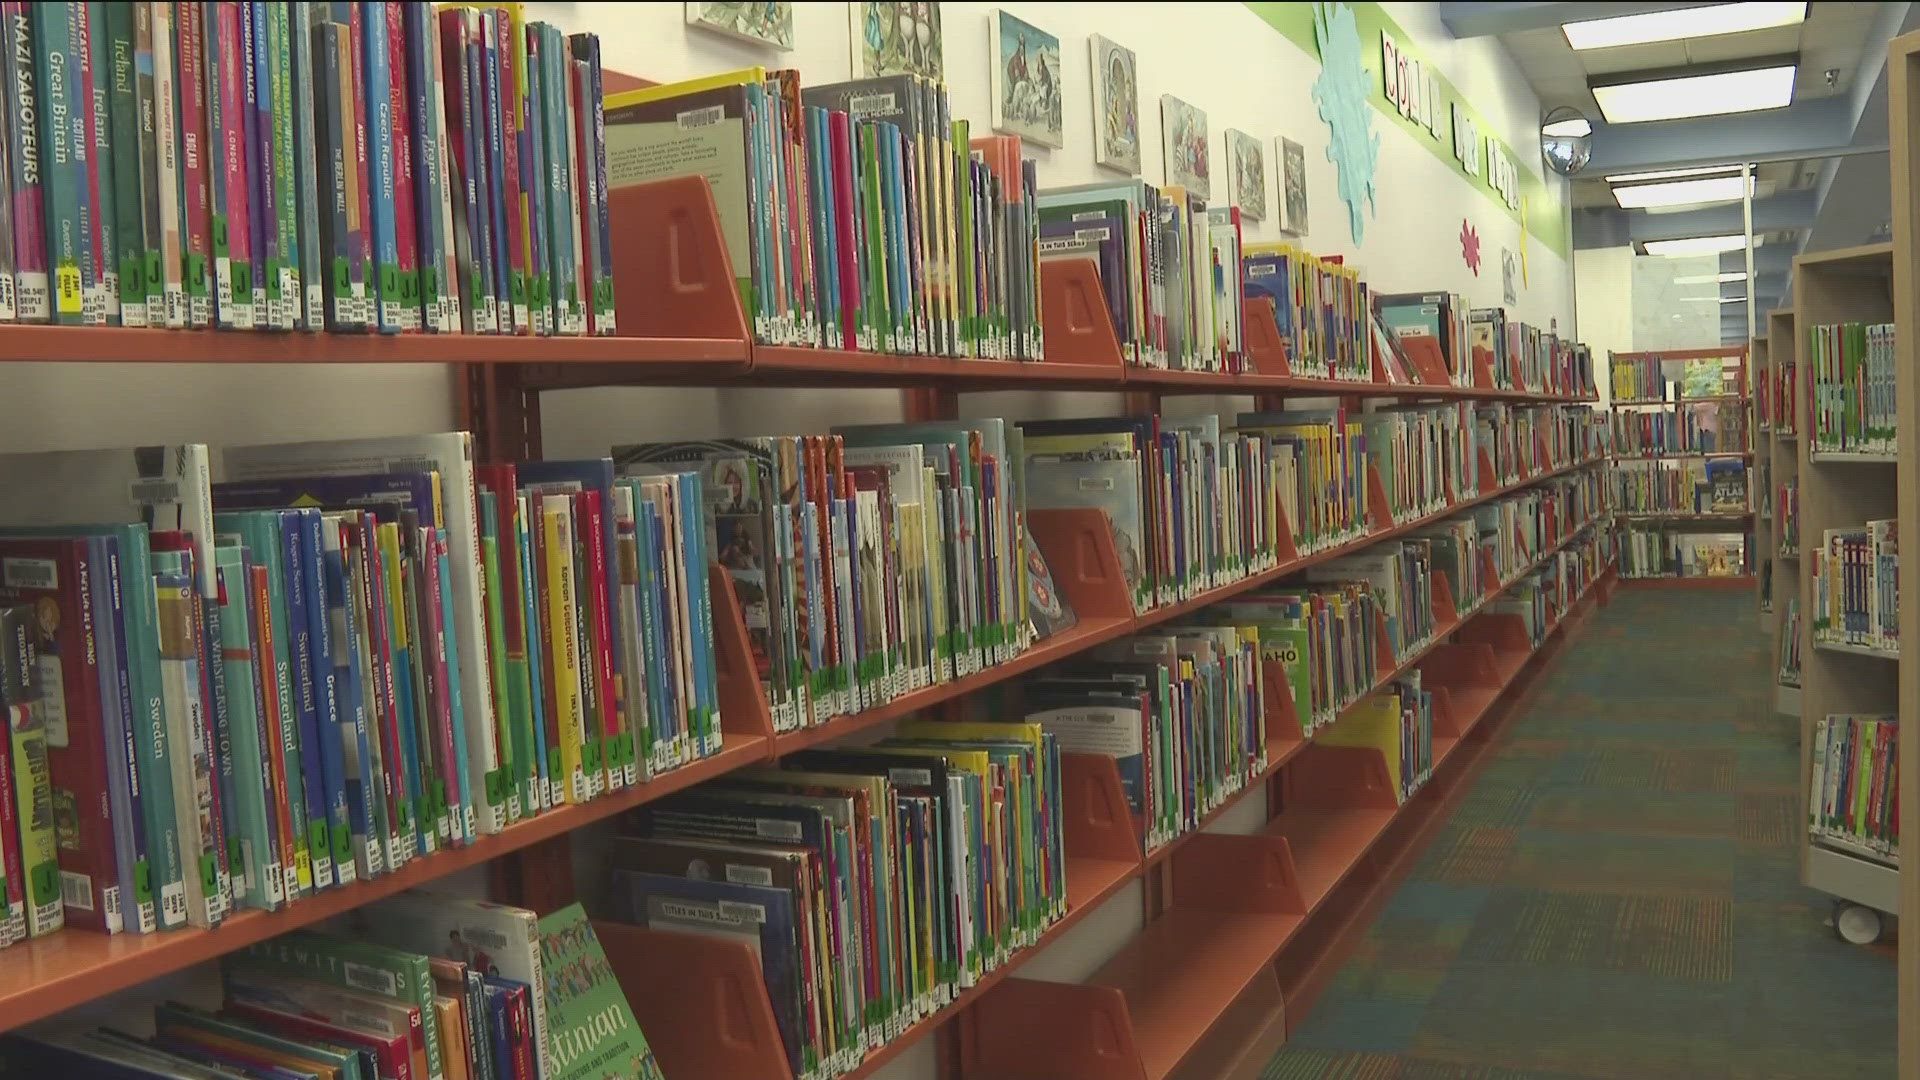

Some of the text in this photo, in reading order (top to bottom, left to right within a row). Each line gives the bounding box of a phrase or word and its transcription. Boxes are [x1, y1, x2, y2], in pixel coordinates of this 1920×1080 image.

[79, 30, 88, 72] CASTLE
[115, 39, 131, 92] Ireland
[14, 15, 38, 184] NAZI SABOTEURS
[246, 65, 255, 103] PALACE
[490, 90, 496, 102] OF
[50, 52, 70, 163] Great Britain
[93, 88, 108, 147] Ireland
[143, 99, 152, 132] Ireland
[390, 87, 402, 131] Poland
[491, 103, 499, 152] VERSAILLES
[72, 118, 85, 161] SCOTLAND
[186, 133, 197, 168] ENGLAND
[228, 130, 237, 172] LONDON
[357, 123, 365, 163] AUSTRIA
[379, 103, 392, 200] Czech Republic
[403, 135, 411, 178] HUNGARY
[335, 161, 344, 190] BERLIN
[428, 140, 437, 185] France
[552, 163, 560, 191] Italy
[336, 192, 345, 213] WALL
[468, 179, 476, 204] FRANCE
[62, 219, 72, 260] Cavendish
[287, 200, 296, 239] STREET
[1714, 487, 1744, 499] ATLAS
[79, 561, 87, 570] A
[361, 551, 367, 559] AT
[80, 571, 89, 591] Kid's
[81, 593, 90, 609] Life
[703, 579, 712, 610] Saudi
[262, 589, 271, 643] NETHERLANDS
[290, 533, 314, 712] Rogers Seavey Switzerland
[561, 566, 574, 669] Korean Celebrations
[643, 591, 654, 662] South Korea
[16, 625, 30, 687] THOMPSON
[27, 643, 36, 666] BEN
[85, 632, 96, 665] VIKING
[208, 606, 218, 634] THE
[220, 733, 231, 776] TOWN
[326, 675, 337, 722] Greece
[384, 662, 394, 707] CROATIA
[192, 703, 201, 740] Sweden
[277, 662, 296, 752] Switzerland
[356, 706, 365, 735] GREECE
[150, 697, 165, 759] Sweden
[100, 790, 109, 819] TWIDDY
[165, 829, 176, 868] Cavendish
[664, 905, 686, 915] TITLES
[421, 971, 439, 1071] EYEWITNESS
[465, 993, 474, 1035] AMERICANS
[550, 1012, 566, 1027] ARE
[603, 1041, 630, 1063] TRADITION
